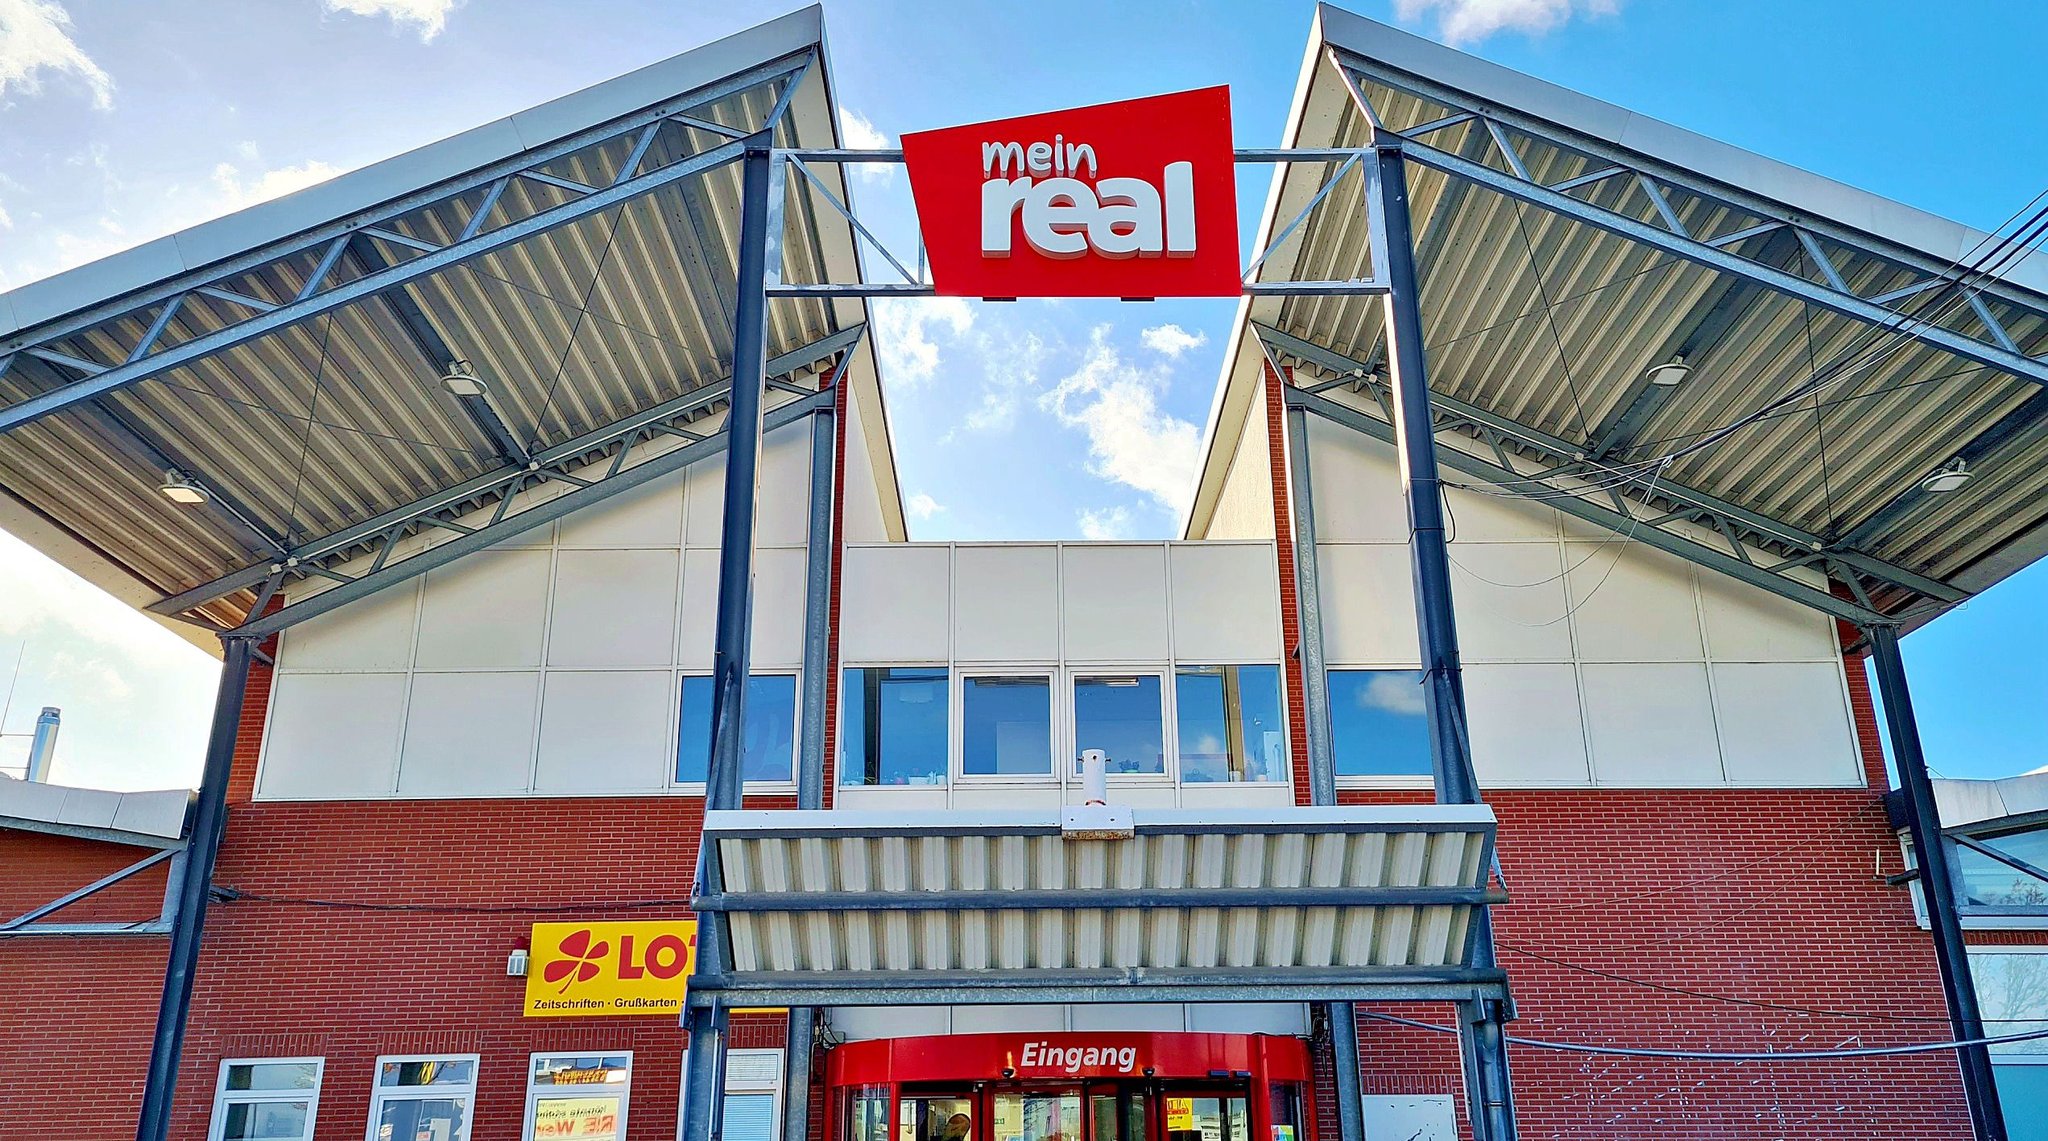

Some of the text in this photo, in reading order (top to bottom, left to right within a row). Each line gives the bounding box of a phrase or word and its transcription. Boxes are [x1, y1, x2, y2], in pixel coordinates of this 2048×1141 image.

[982, 134, 1097, 178] mein
[981, 161, 1196, 258] real
[533, 997, 678, 1010] Zeitschriften Grußkarten
[1020, 1040, 1137, 1073] Eingang
